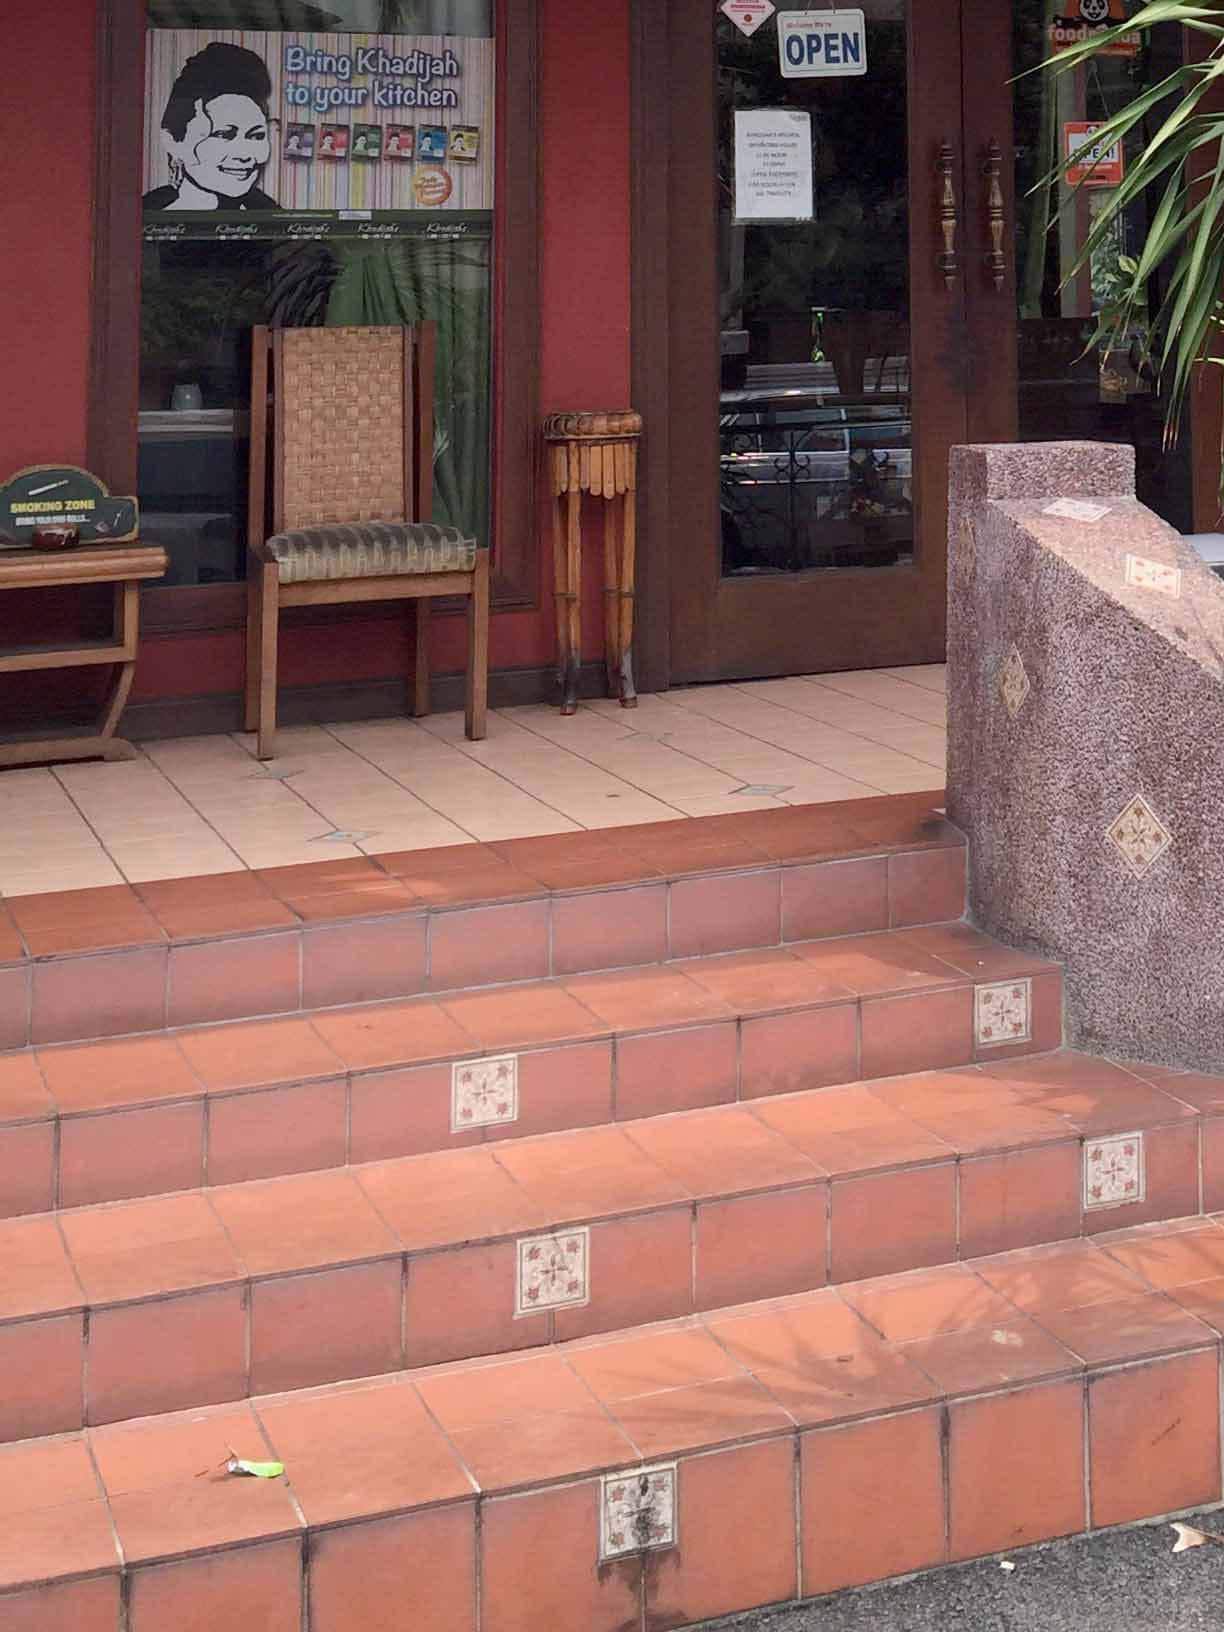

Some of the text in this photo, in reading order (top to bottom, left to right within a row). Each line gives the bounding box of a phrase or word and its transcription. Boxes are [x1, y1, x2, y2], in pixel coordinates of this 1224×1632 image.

[286, 46, 458, 83] Bring Khadijah
[786, 31, 860, 66] OPEN
[286, 80, 457, 112] to your kitchen
[64, 499, 96, 511] ZONE
